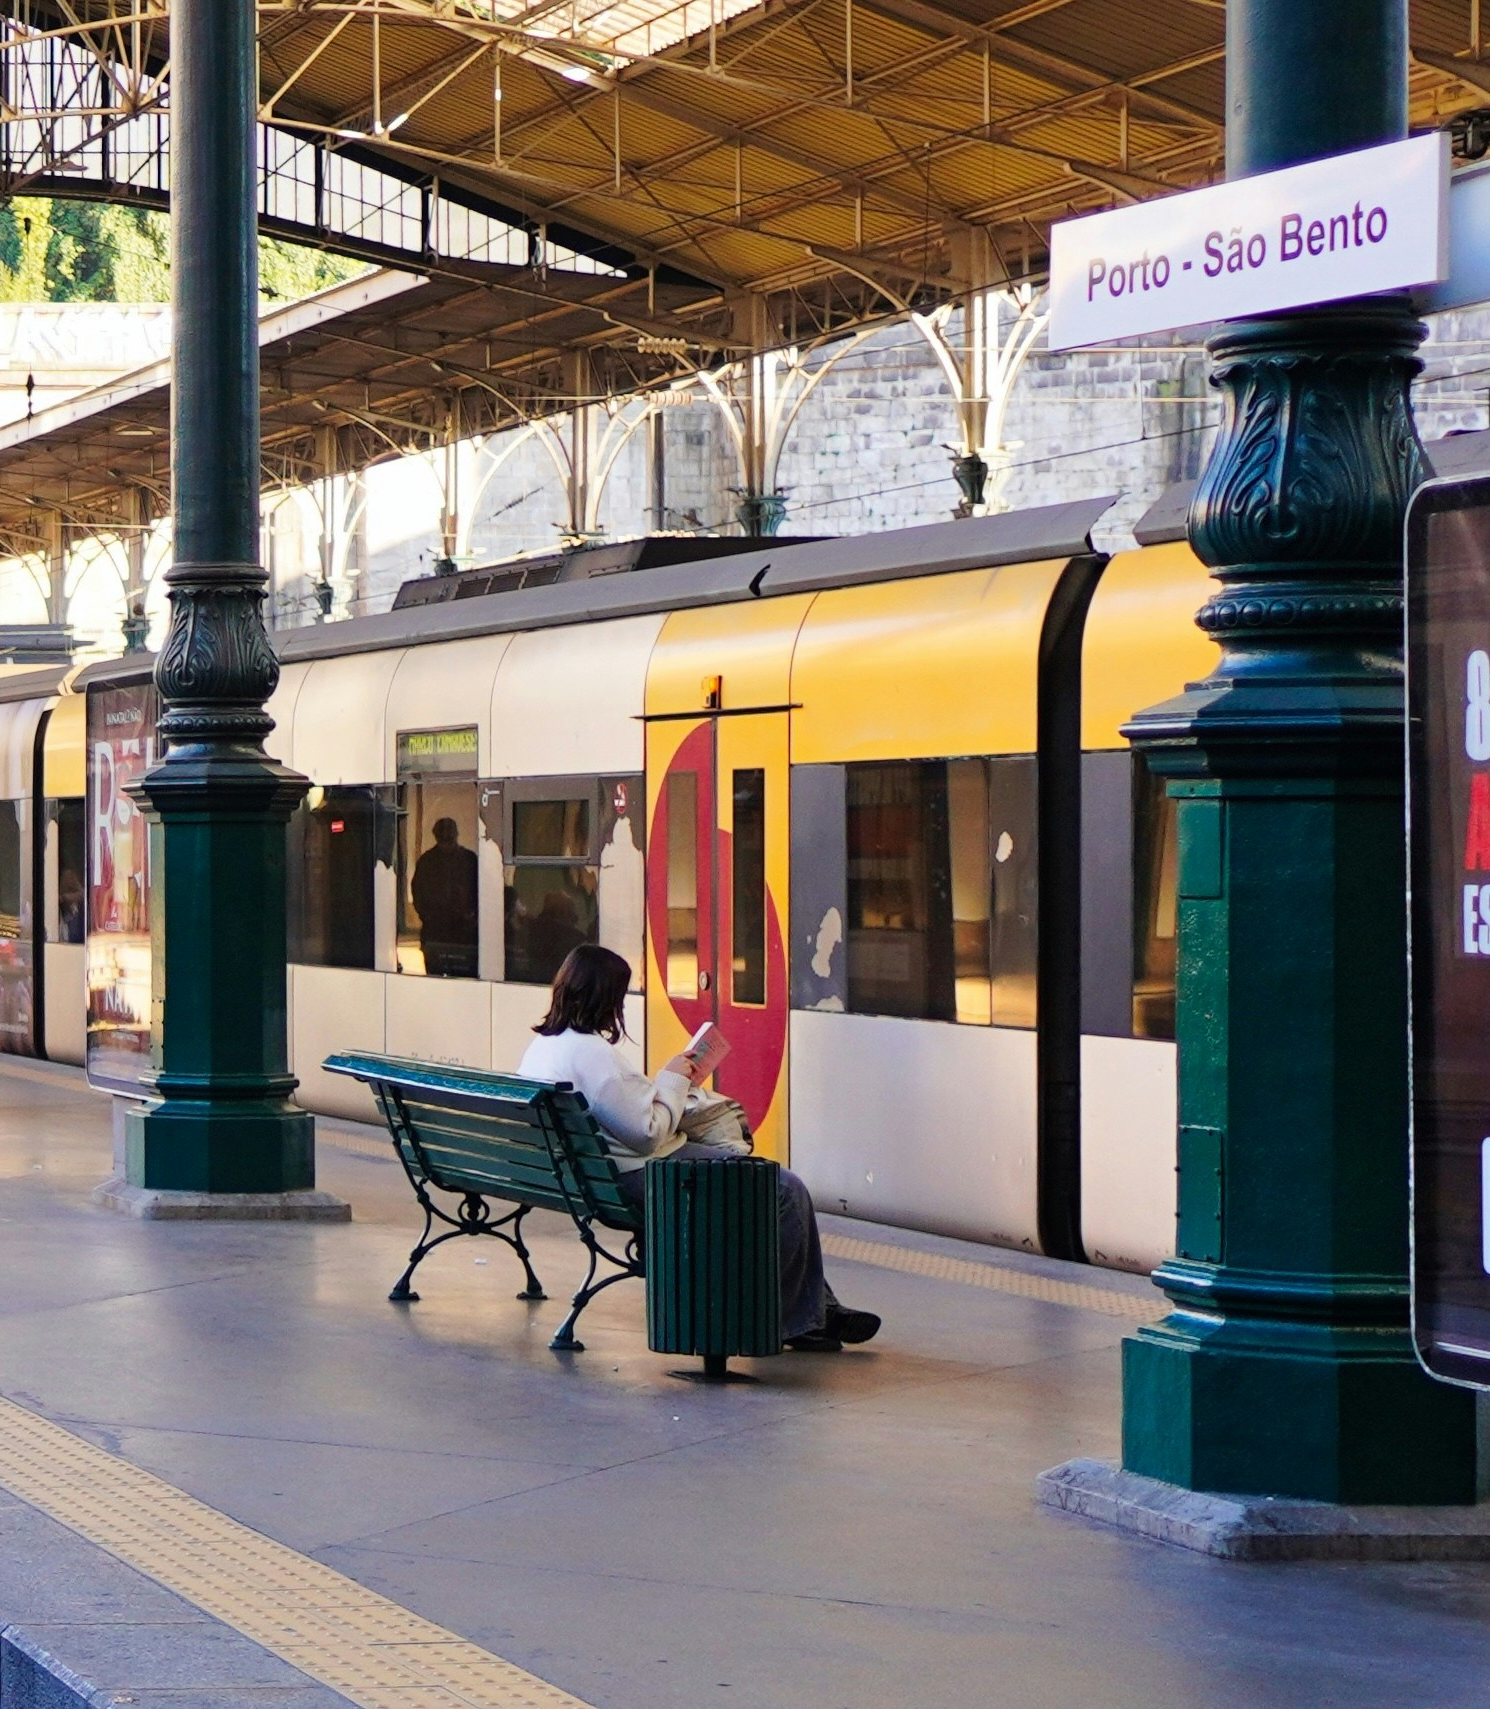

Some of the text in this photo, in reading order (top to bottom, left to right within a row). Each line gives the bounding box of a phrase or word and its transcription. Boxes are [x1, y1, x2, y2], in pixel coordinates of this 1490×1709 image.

[1087, 200, 1387, 302] Porto - São Bento
